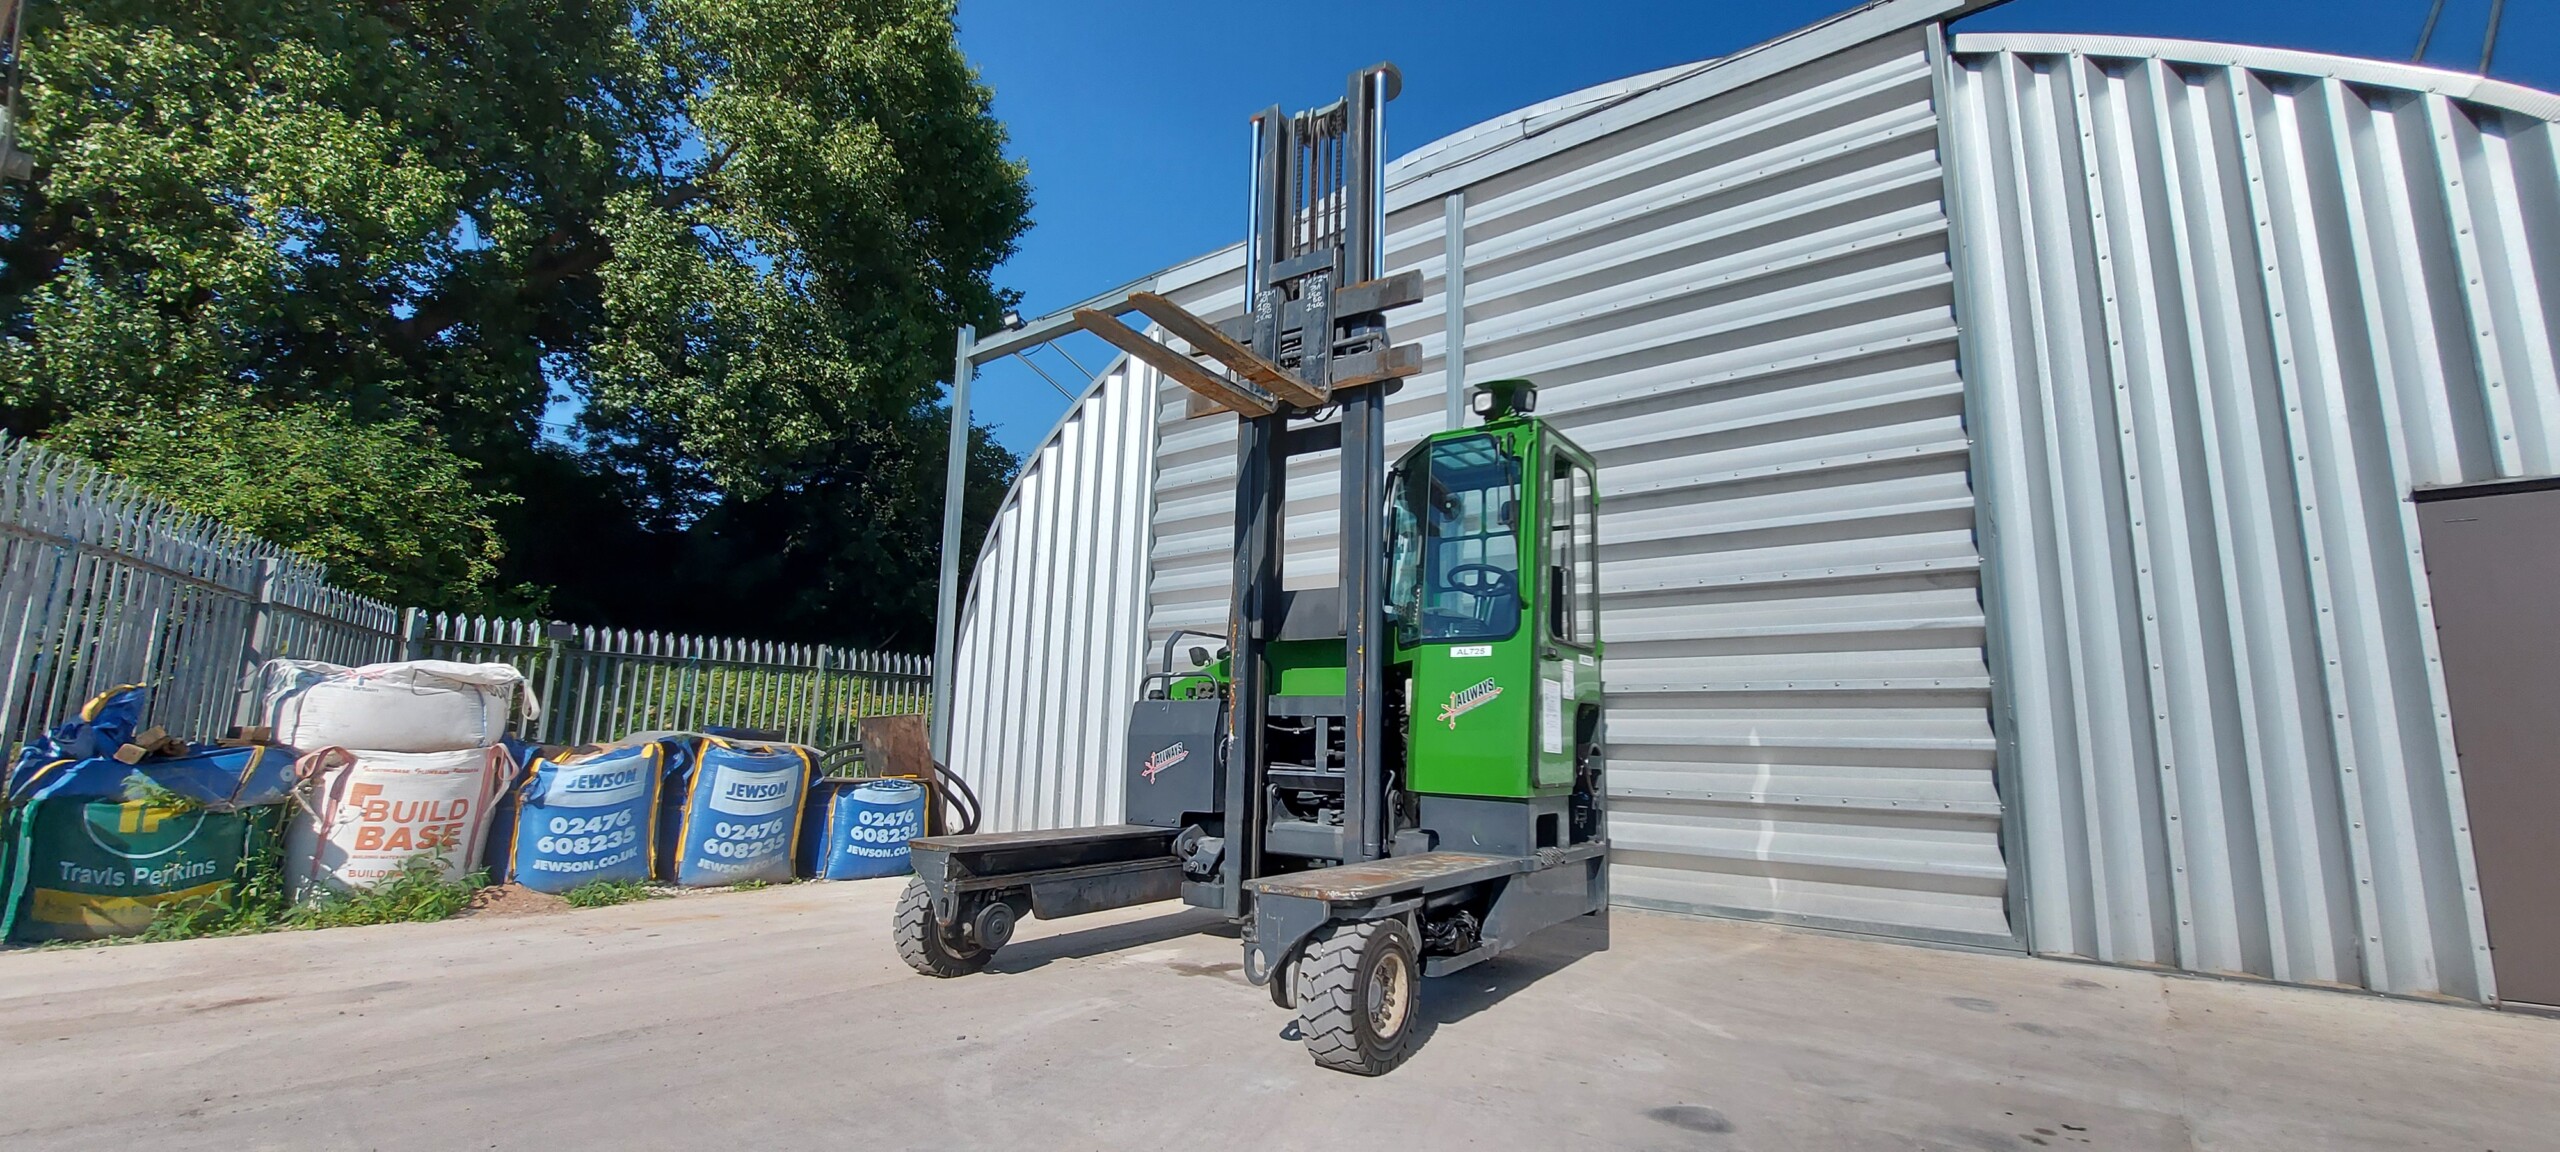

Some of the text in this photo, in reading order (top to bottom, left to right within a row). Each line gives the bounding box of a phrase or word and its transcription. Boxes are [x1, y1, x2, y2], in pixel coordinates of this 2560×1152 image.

[1457, 678, 1494, 707] ALLWAYS
[565, 768, 637, 789] JEWSON
[726, 781, 788, 799] JEWSON
[363, 799, 469, 823] BUILD
[549, 808, 632, 835] 02476
[859, 809, 914, 827] 02476
[355, 822, 464, 851] BASE
[537, 826, 636, 855] 608235
[715, 817, 783, 840] 02476
[850, 823, 918, 843] 608235
[703, 833, 786, 859] 608235
[846, 844, 912, 858] JEWSON.CO.
[532, 846, 638, 873] JEWSON.CO.UK
[60, 860, 216, 886] Travis Perkins
